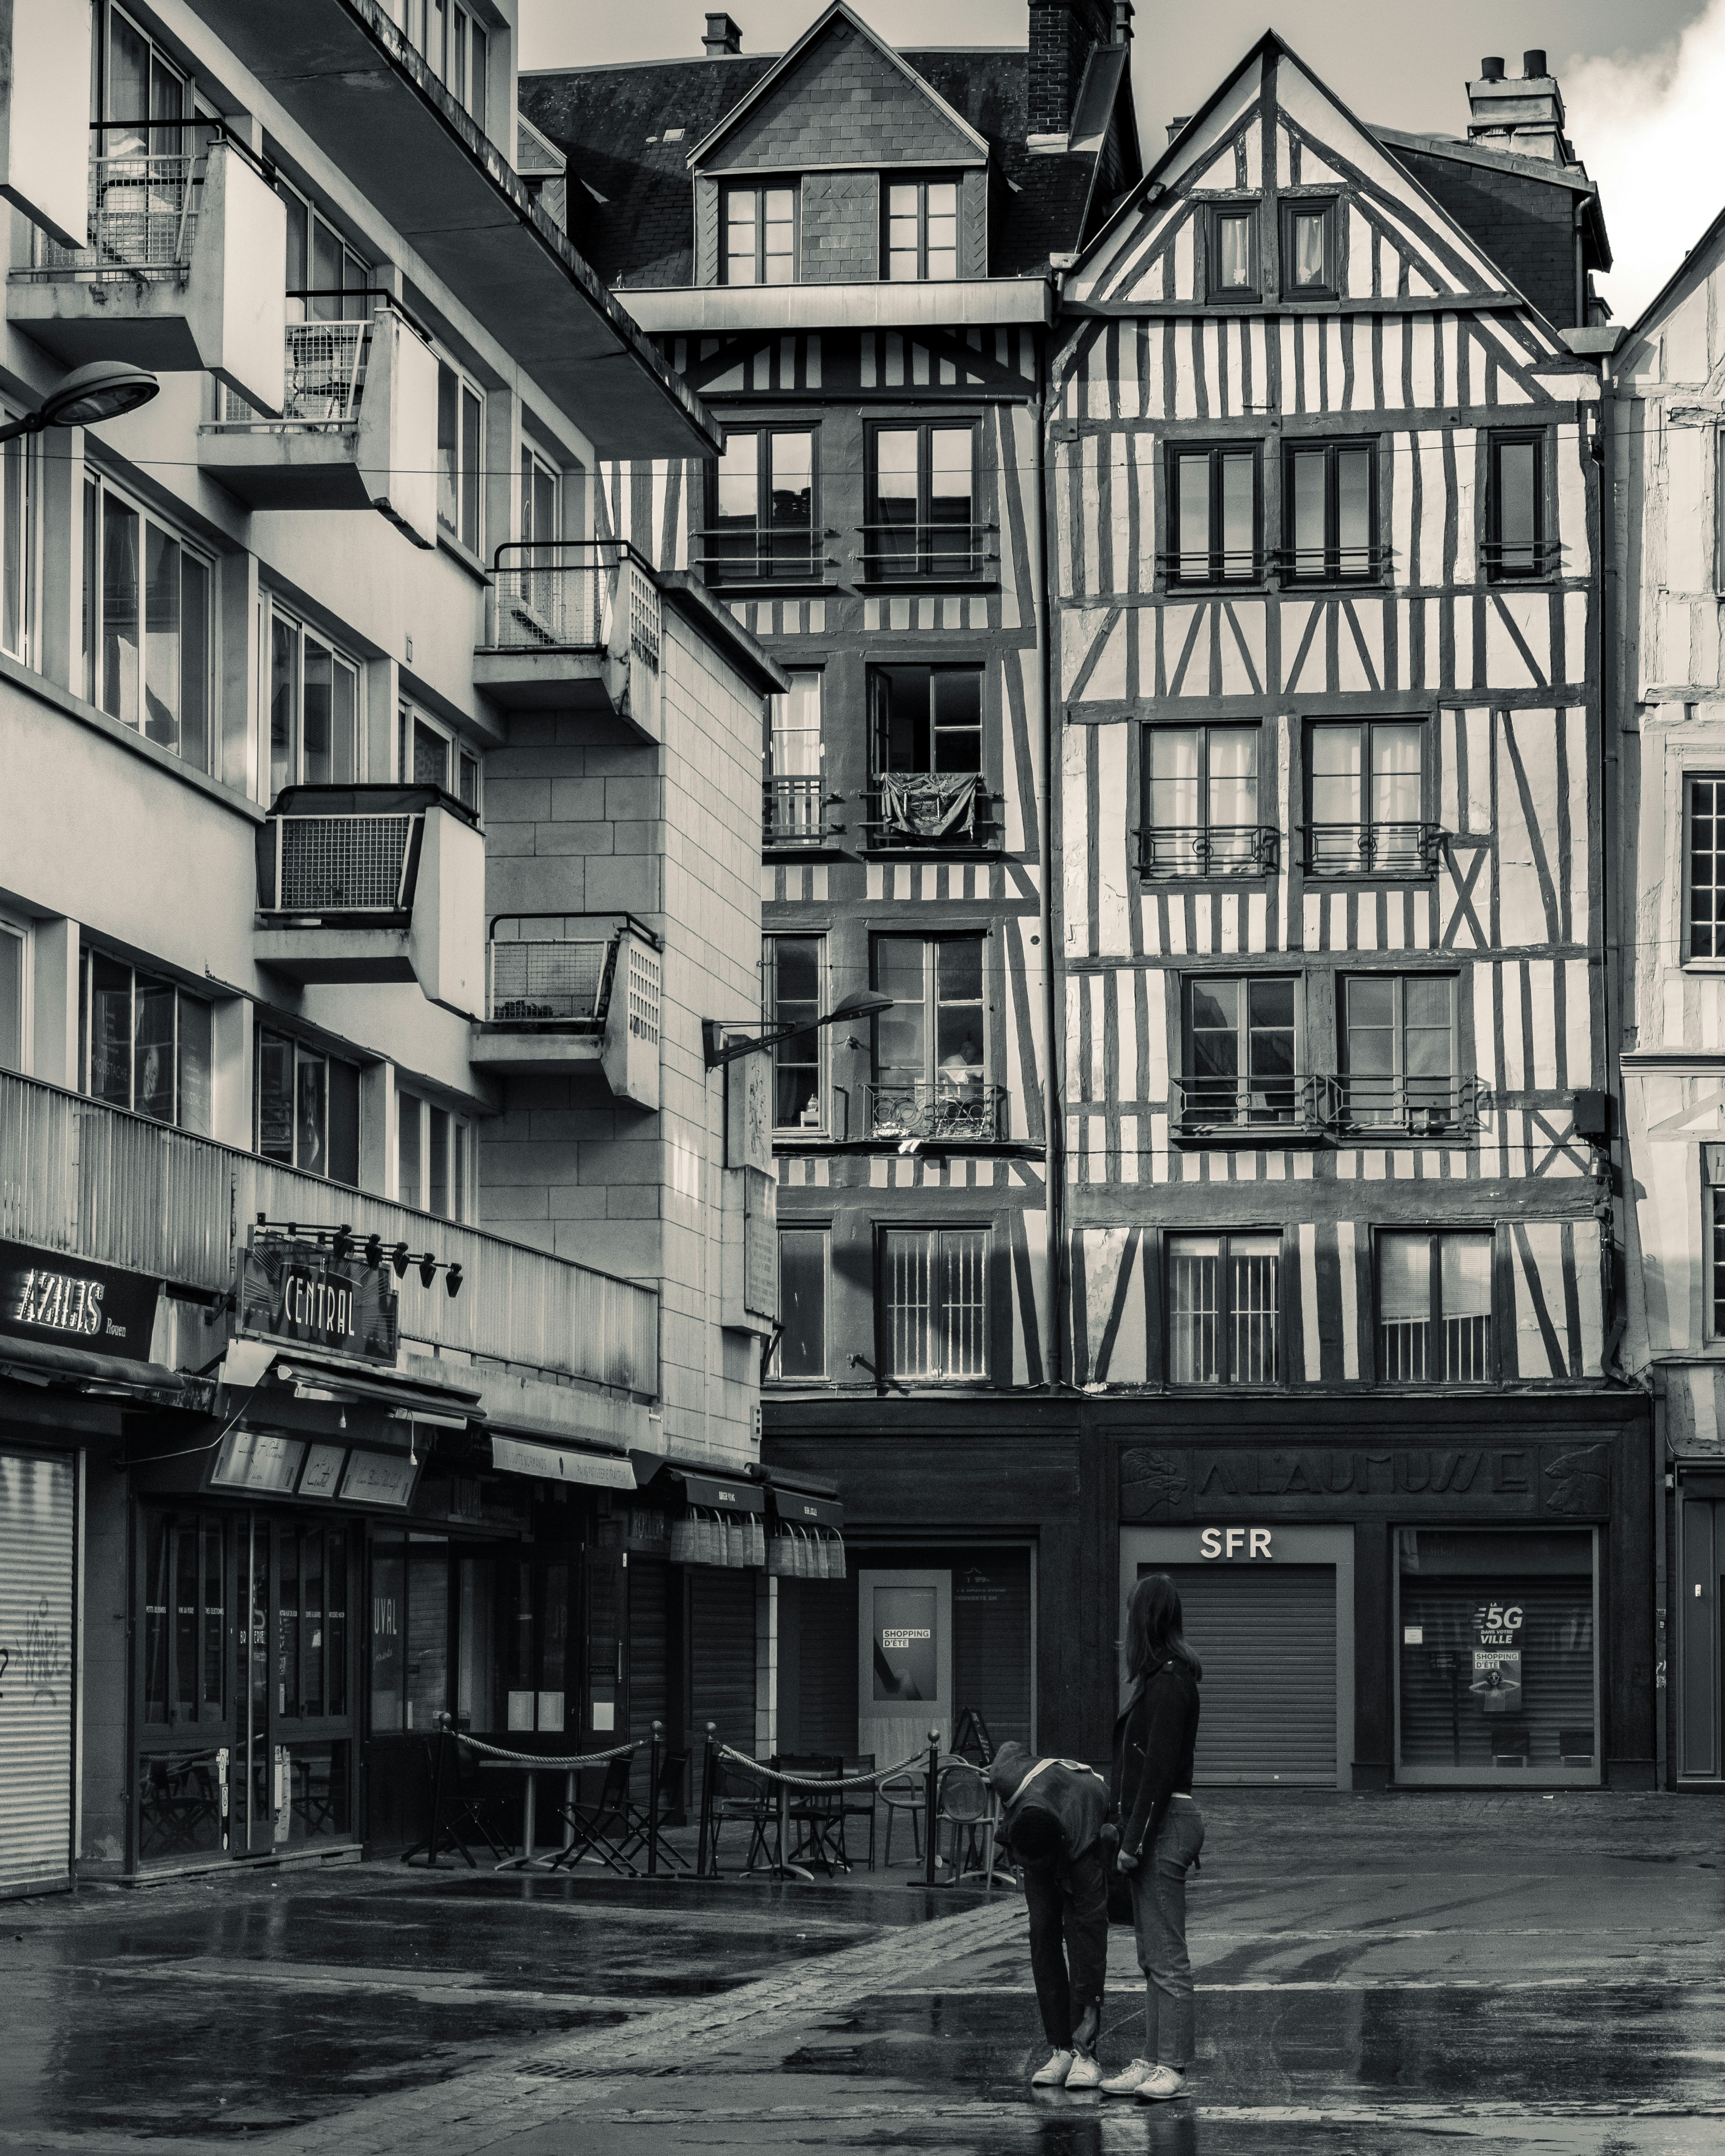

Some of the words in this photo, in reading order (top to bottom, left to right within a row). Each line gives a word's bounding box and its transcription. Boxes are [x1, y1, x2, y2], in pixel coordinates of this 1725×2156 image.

[320, 1257, 325, 1273] LE
[18, 1268, 106, 1335] AZILIS
[106, 1317, 126, 1337] Rouen
[285, 1275, 354, 1336] CENTRAL
[1201, 1528, 1272, 1558] SFR
[1486, 1607, 1523, 1629] 5G
[884, 1630, 929, 1638] SHOPPING
[884, 1638, 908, 1648] D'ÉTÉ
[1481, 1635, 1513, 1644] VILLE
